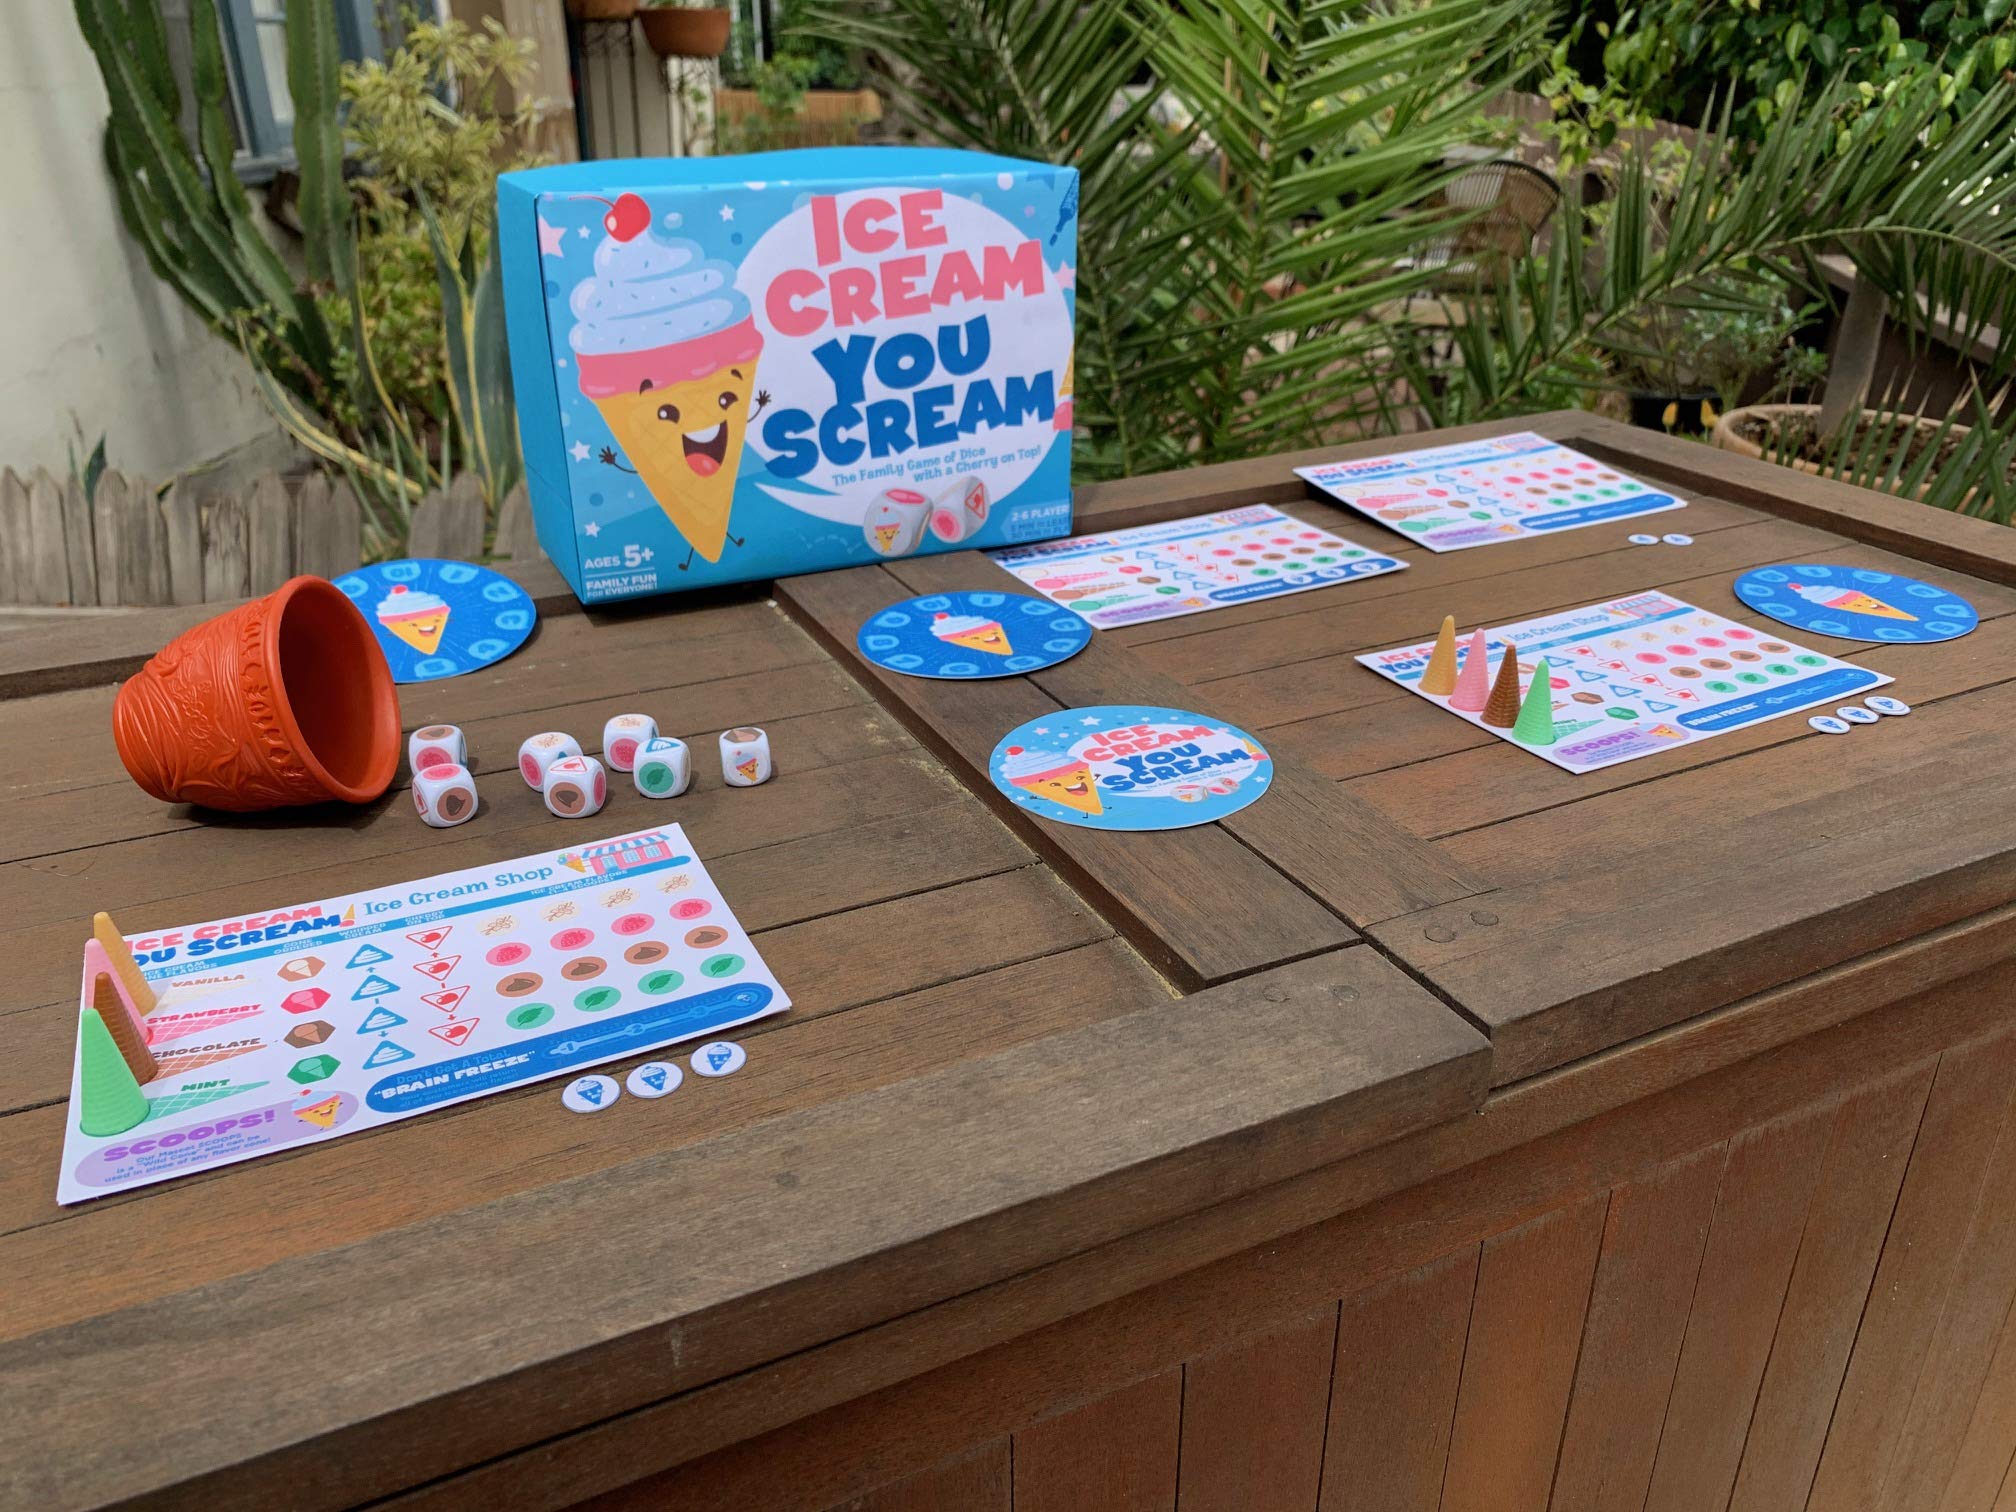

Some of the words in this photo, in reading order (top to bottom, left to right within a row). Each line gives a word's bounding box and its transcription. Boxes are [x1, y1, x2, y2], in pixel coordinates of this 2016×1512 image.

[810, 189, 948, 267] ICE
[765, 239, 1045, 337] CREAM
[812, 314, 991, 403] YOU
[762, 369, 1056, 479] SCREAM
[832, 474, 856, 487] The
[859, 463, 904, 481] Family
[907, 457, 940, 471] Game
[944, 451, 956, 463] of
[960, 446, 986, 460] Dice
[913, 466, 942, 482] with
[945, 465, 953, 475] a
[955, 455, 998, 473] Cherry
[1001, 453, 1015, 464] on
[1017, 445, 1042, 461] Top!
[1031, 504, 1070, 519] PLAYER
[584, 555, 620, 569] AGES
[624, 544, 654, 567] 5+
[586, 576, 629, 590] FAMILY
[631, 573, 657, 584] FUN
[587, 590, 604, 598] FOR
[604, 582, 658, 596] EVERYONE!
[1379, 652, 1415, 663] ICE
[1379, 659, 1425, 673] YOU
[1082, 726, 1216, 761] CREAM
[1090, 724, 1156, 746] ICE
[1560, 731, 1640, 755] SCOOPS!
[1113, 742, 1201, 770] YOU
[1102, 748, 1252, 791] SCREAM
[363, 898, 403, 915] Ice
[409, 880, 488, 905] Cream
[494, 866, 553, 888] Shop
[192, 905, 322, 940] CREAM
[338, 923, 386, 936] WHIPPED
[283, 938, 313, 948] CONE
[133, 946, 177, 967] OU
[171, 974, 246, 988] VANILLA
[147, 1003, 262, 1025] STRAWBERRY
[151, 1037, 261, 1059] CHOCOLATE
[374, 1073, 450, 1100] "BRAIN
[454, 1050, 536, 1080] FREEZE"
[396, 1066, 433, 1084] Don't
[435, 1062, 459, 1075] Get
[462, 1058, 472, 1068] A
[474, 1048, 512, 1064] Total
[180, 1079, 230, 1092] MINT
[103, 1109, 276, 1162] SCOOPS!
